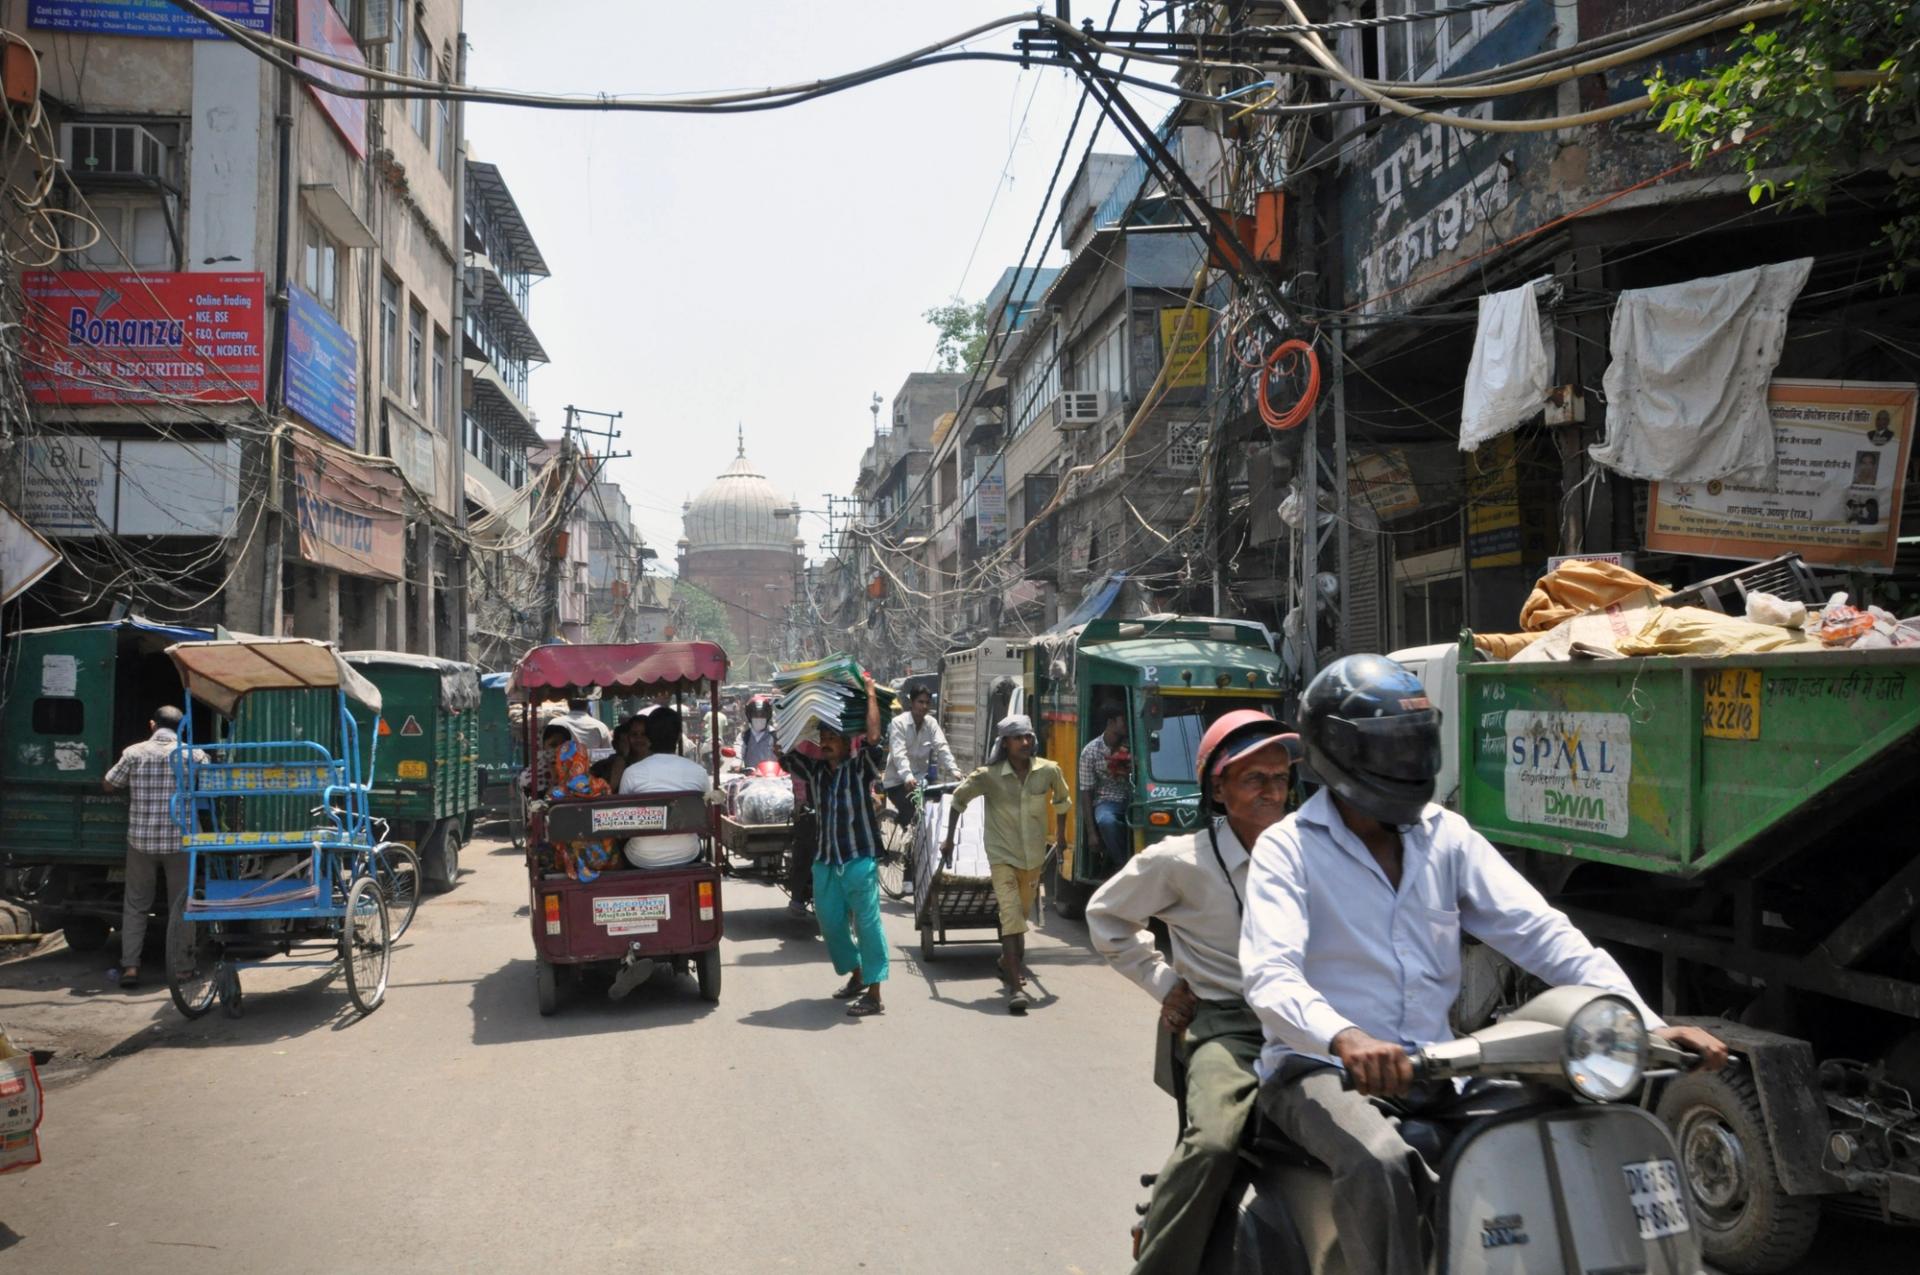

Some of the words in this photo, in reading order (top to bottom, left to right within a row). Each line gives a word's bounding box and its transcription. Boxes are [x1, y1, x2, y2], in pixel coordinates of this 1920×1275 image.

[196, 294, 221, 306] Online
[223, 295, 251, 308] Trading
[195, 311, 212, 324] NSE,
[214, 311, 229, 323] BSE
[69, 306, 185, 347] Bonanza
[215, 328, 248, 342] Currency
[216, 345, 242, 356] NCDEX
[243, 345, 260, 356] ETC.
[115, 362, 205, 377] SECURITIES
[1144, 665, 1159, 682] P.
[1151, 786, 1178, 798] CNG
[1544, 788, 1605, 821] DWM
[611, 807, 664, 816] ACCOUNTS
[637, 818, 664, 826] Zaidi
[612, 899, 664, 908] ACCOUNTS
